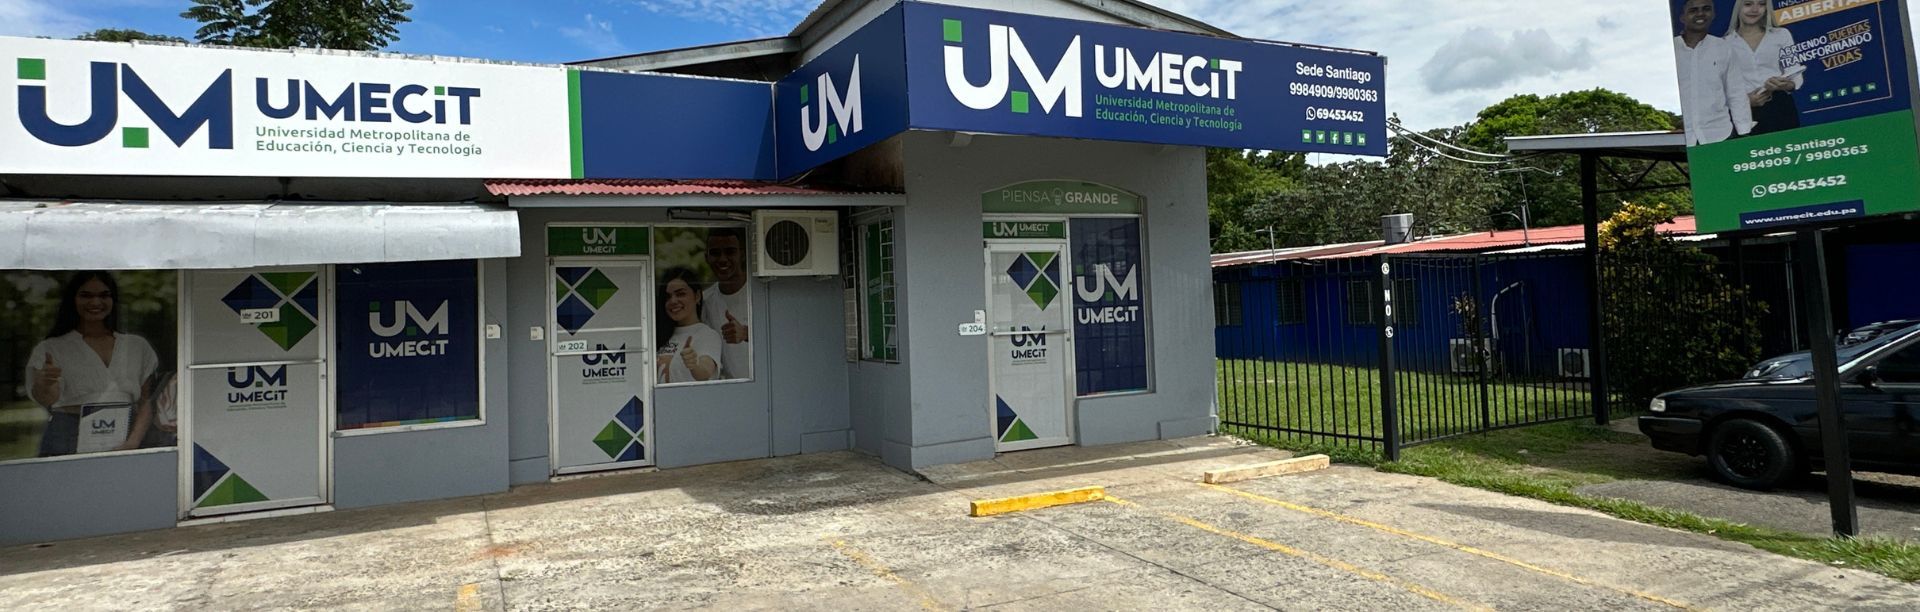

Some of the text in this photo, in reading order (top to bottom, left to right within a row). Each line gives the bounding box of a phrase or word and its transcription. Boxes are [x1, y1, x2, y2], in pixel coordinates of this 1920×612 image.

[1780, 0, 1870, 22] ABIERT
[1780, 21, 1871, 58] ABRIENDO PUERTAS
[1780, 32, 1872, 68] TRANSFORMANDO
[1822, 49, 1863, 68] VIDAS
[1296, 62, 1371, 84] Sede Santiago
[1289, 82, 1377, 102] 9984909/9980363
[1095, 94, 1235, 116] Universidad Metropolitana de
[1095, 109, 1242, 131] Educación, Ciencia y Tecnología
[1316, 108, 1364, 122] 69453452
[256, 126, 471, 142] Universidad Metropolitana de
[256, 140, 482, 156] Educación, Ciencia y Tecnología
[1750, 136, 1845, 158] Sede Santiago
[1733, 156, 1791, 173] 9984909
[1806, 144, 1868, 162] 9980363
[1768, 175, 1847, 194] 69453452
[1002, 190, 1118, 204] PIENSA GRANDE
[1745, 207, 1857, 225] www.umecit.edu.pa
[254, 311, 273, 320] 201
[969, 325, 983, 333] 204
[568, 342, 584, 350] 202
